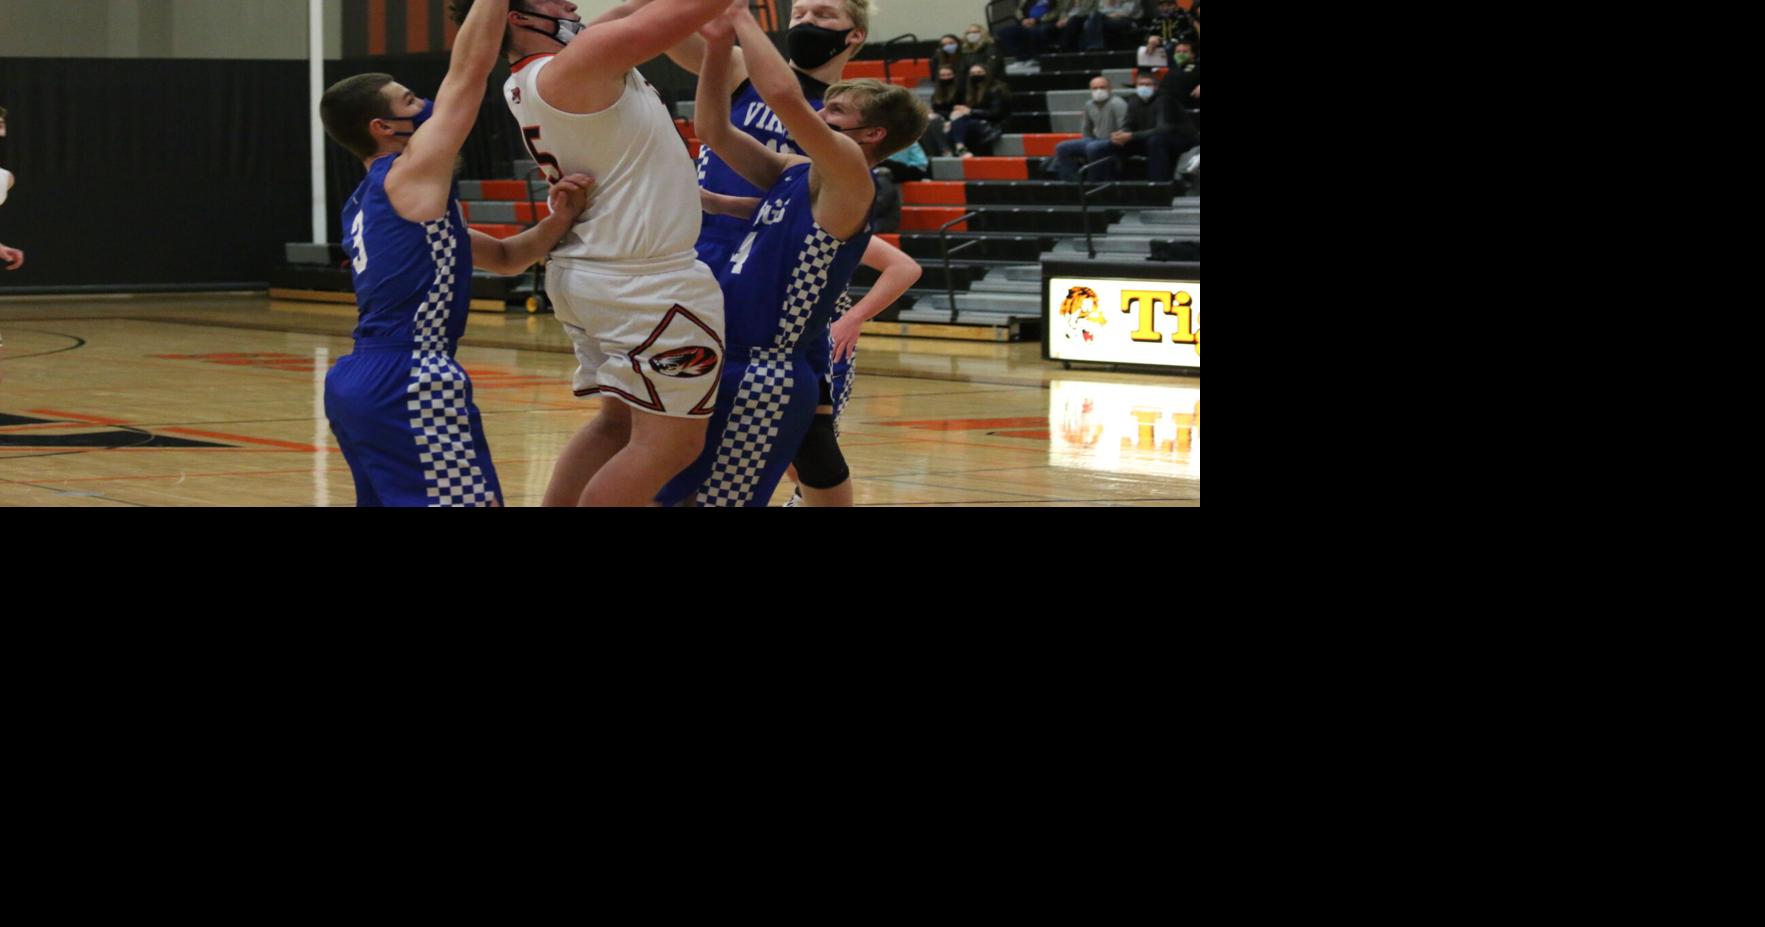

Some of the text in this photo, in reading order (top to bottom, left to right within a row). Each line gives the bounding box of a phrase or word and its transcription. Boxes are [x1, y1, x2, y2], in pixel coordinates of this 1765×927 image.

[744, 102, 793, 140] VIK
[522, 126, 564, 184] 5
[351, 210, 368, 274] 3
[730, 232, 758, 274] 4
[1121, 290, 1200, 356] Ti
